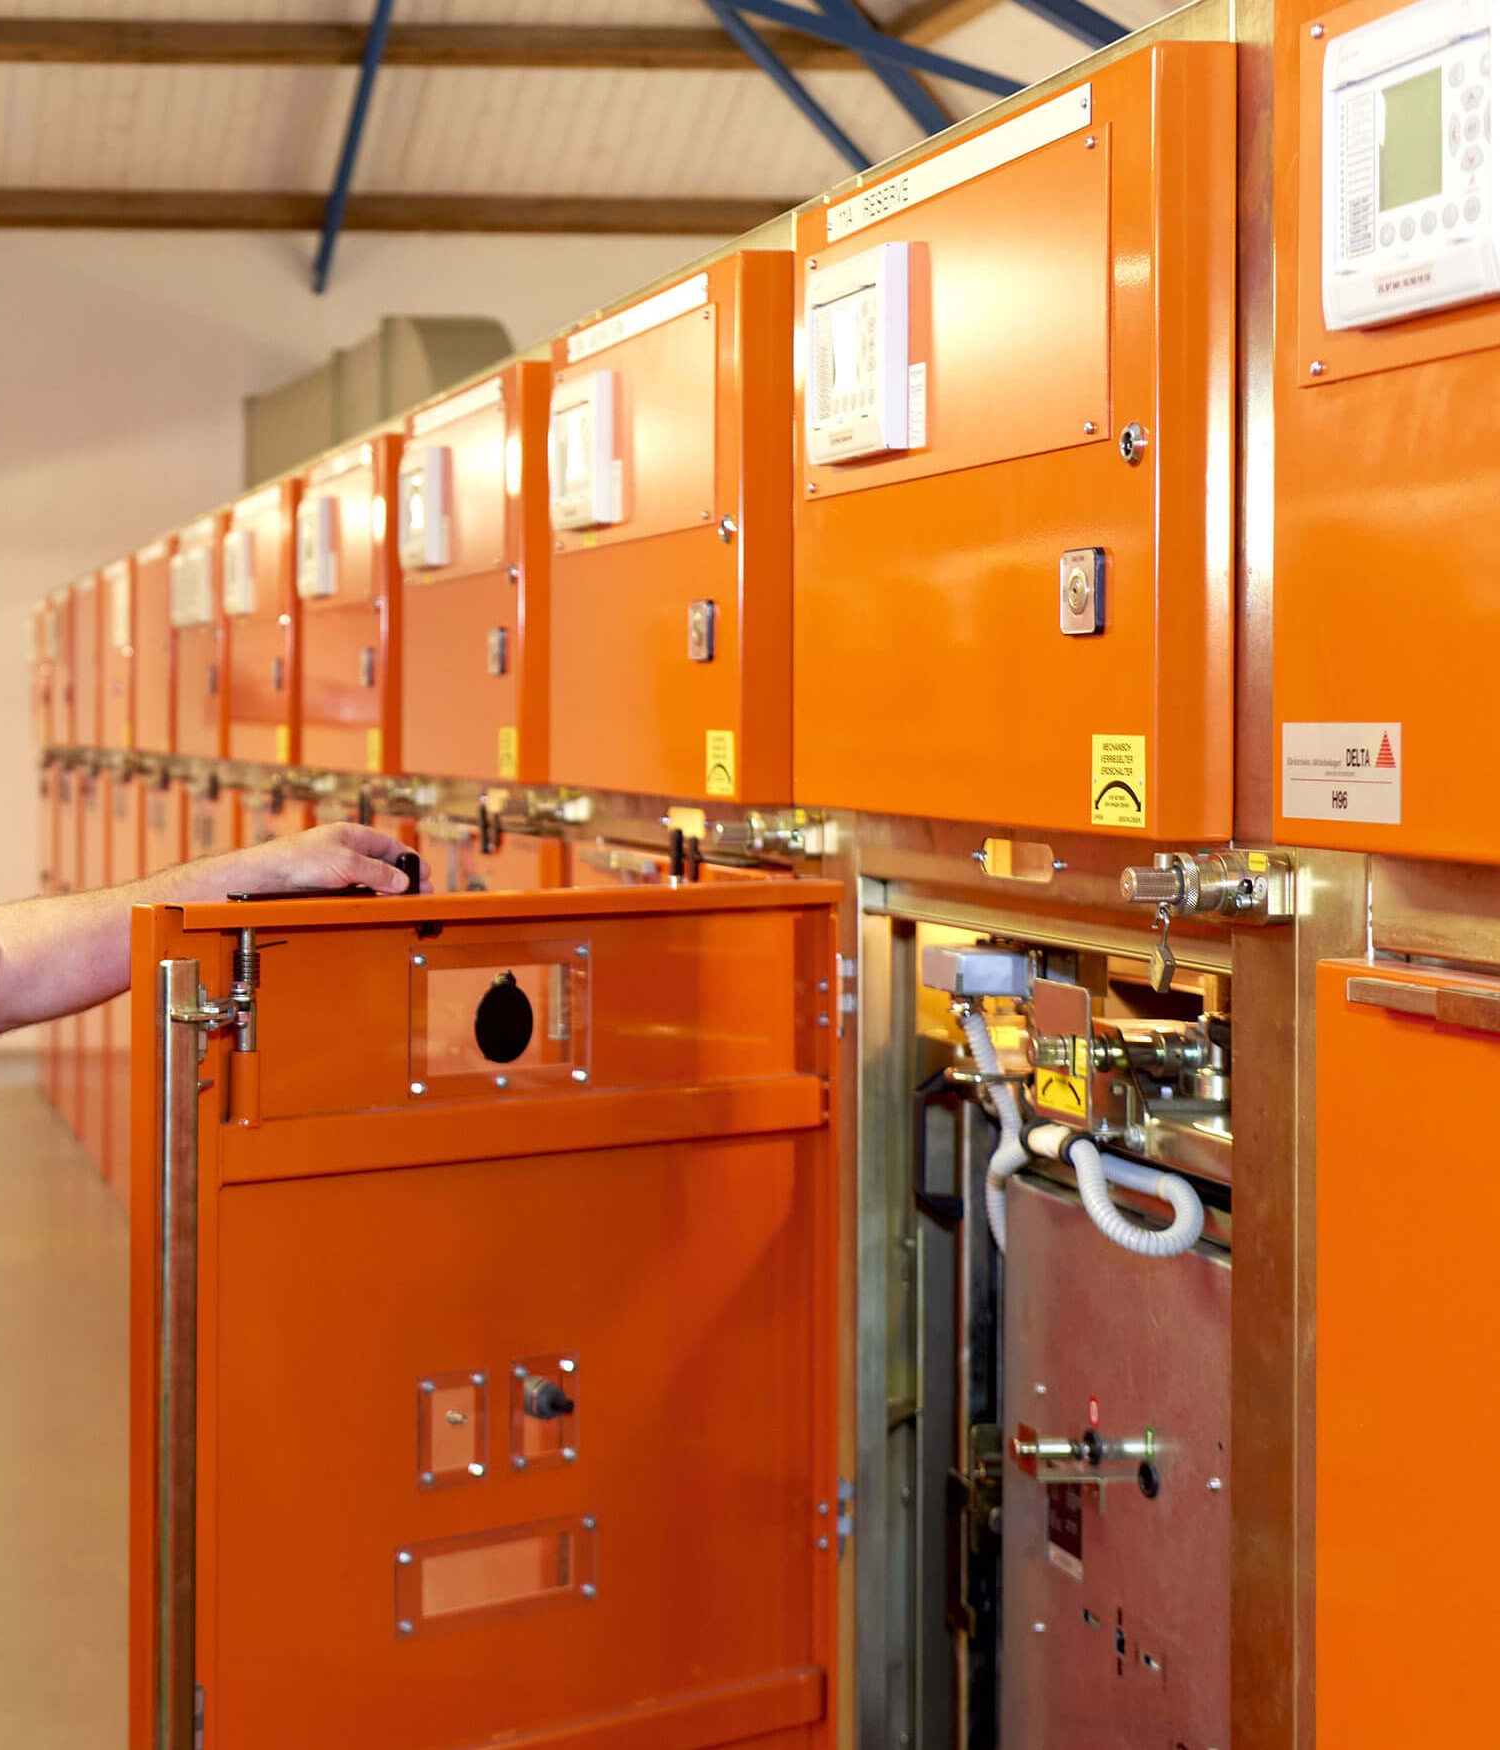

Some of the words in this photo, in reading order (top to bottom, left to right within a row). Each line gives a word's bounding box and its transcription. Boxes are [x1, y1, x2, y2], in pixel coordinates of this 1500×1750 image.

[863, 178, 909, 220] RESERVE
[1346, 748, 1371, 767] DELTA
[1331, 790, 1348, 809] H96
